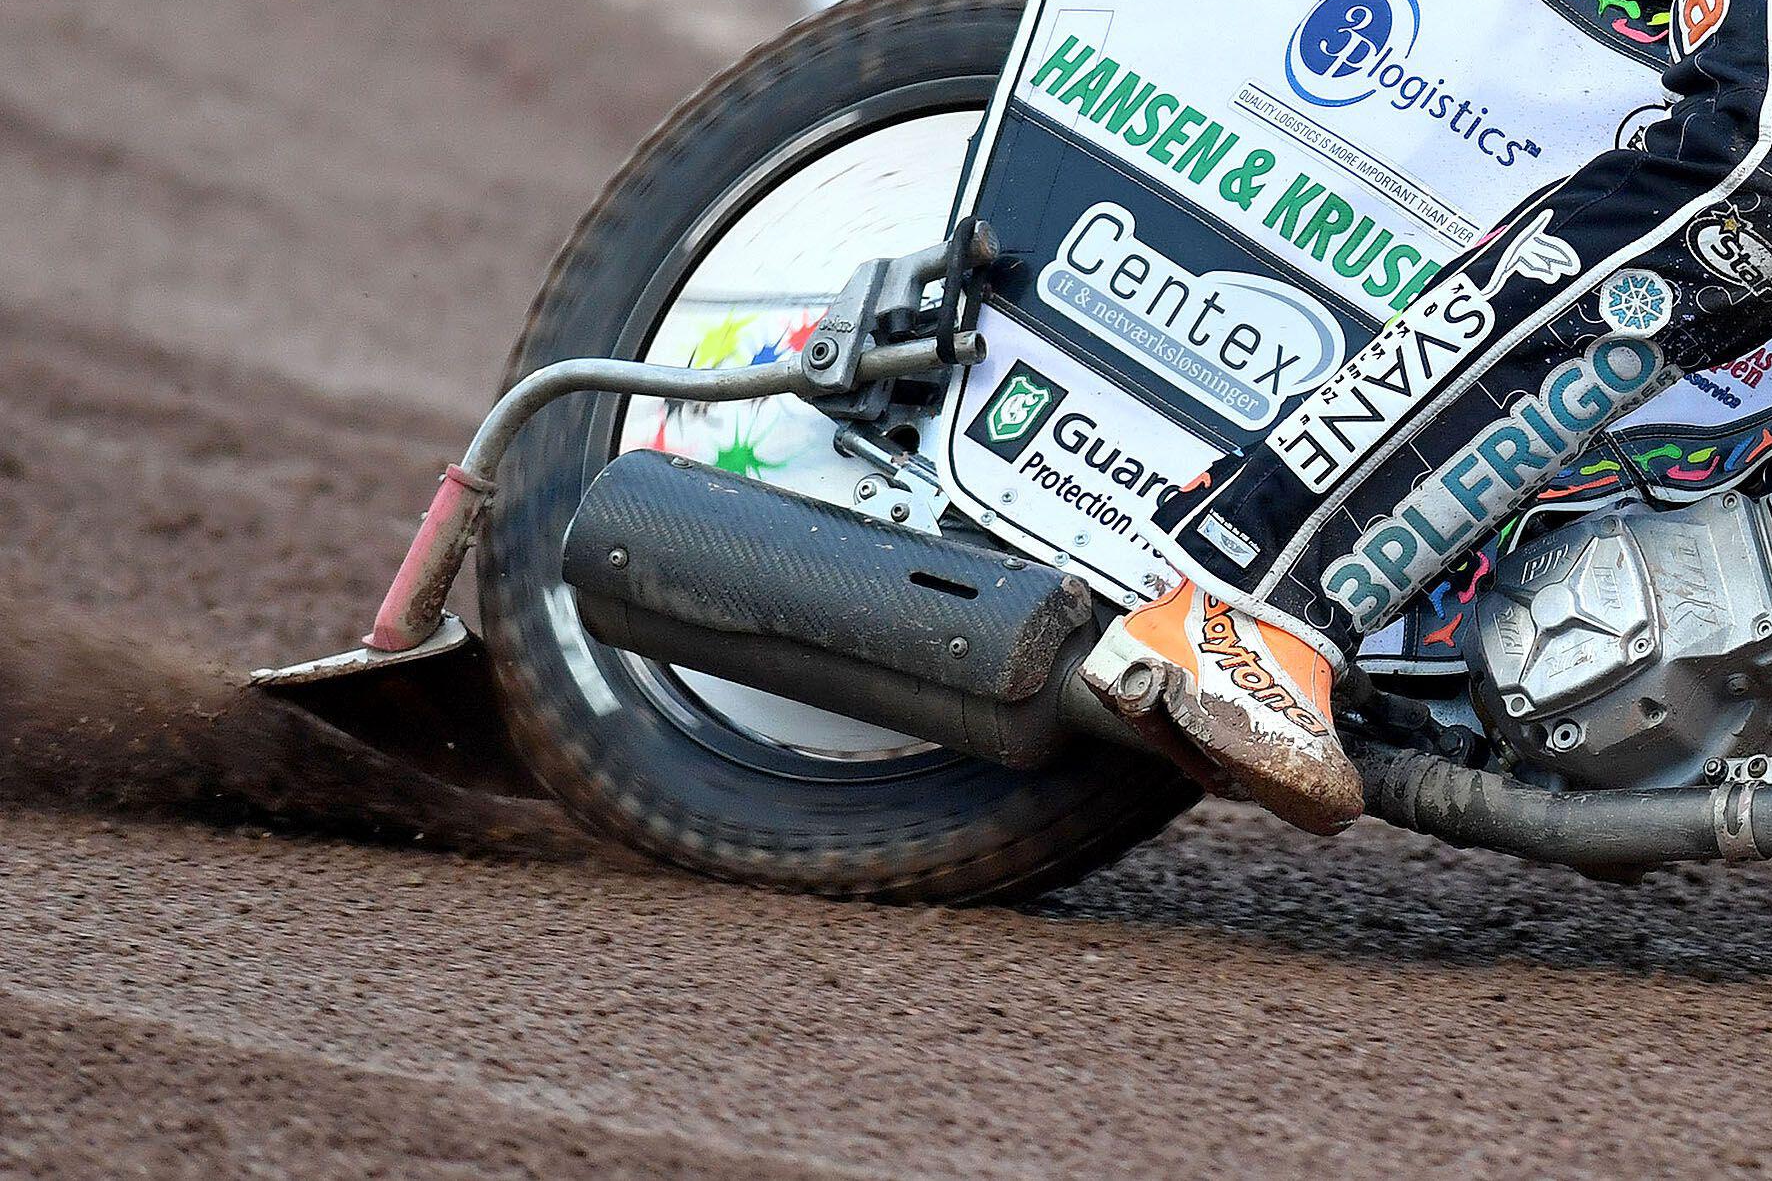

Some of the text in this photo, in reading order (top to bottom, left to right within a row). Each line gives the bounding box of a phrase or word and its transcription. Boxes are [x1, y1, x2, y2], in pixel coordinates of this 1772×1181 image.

[1030, 35, 1239, 185] HANSEN
[1218, 148, 1277, 212] &
[1238, 89, 1475, 244] QUALITY LOGISTICS IS MORE IMPORTANT THAN EVER
[1055, 274, 1074, 292] it
[1074, 286, 1093, 308] &
[1067, 213, 1301, 395] Centex
[1284, 293, 1487, 487] SVANE
[1019, 451, 1133, 536] Protection
[1327, 337, 1659, 632] 3PLFRIGO
